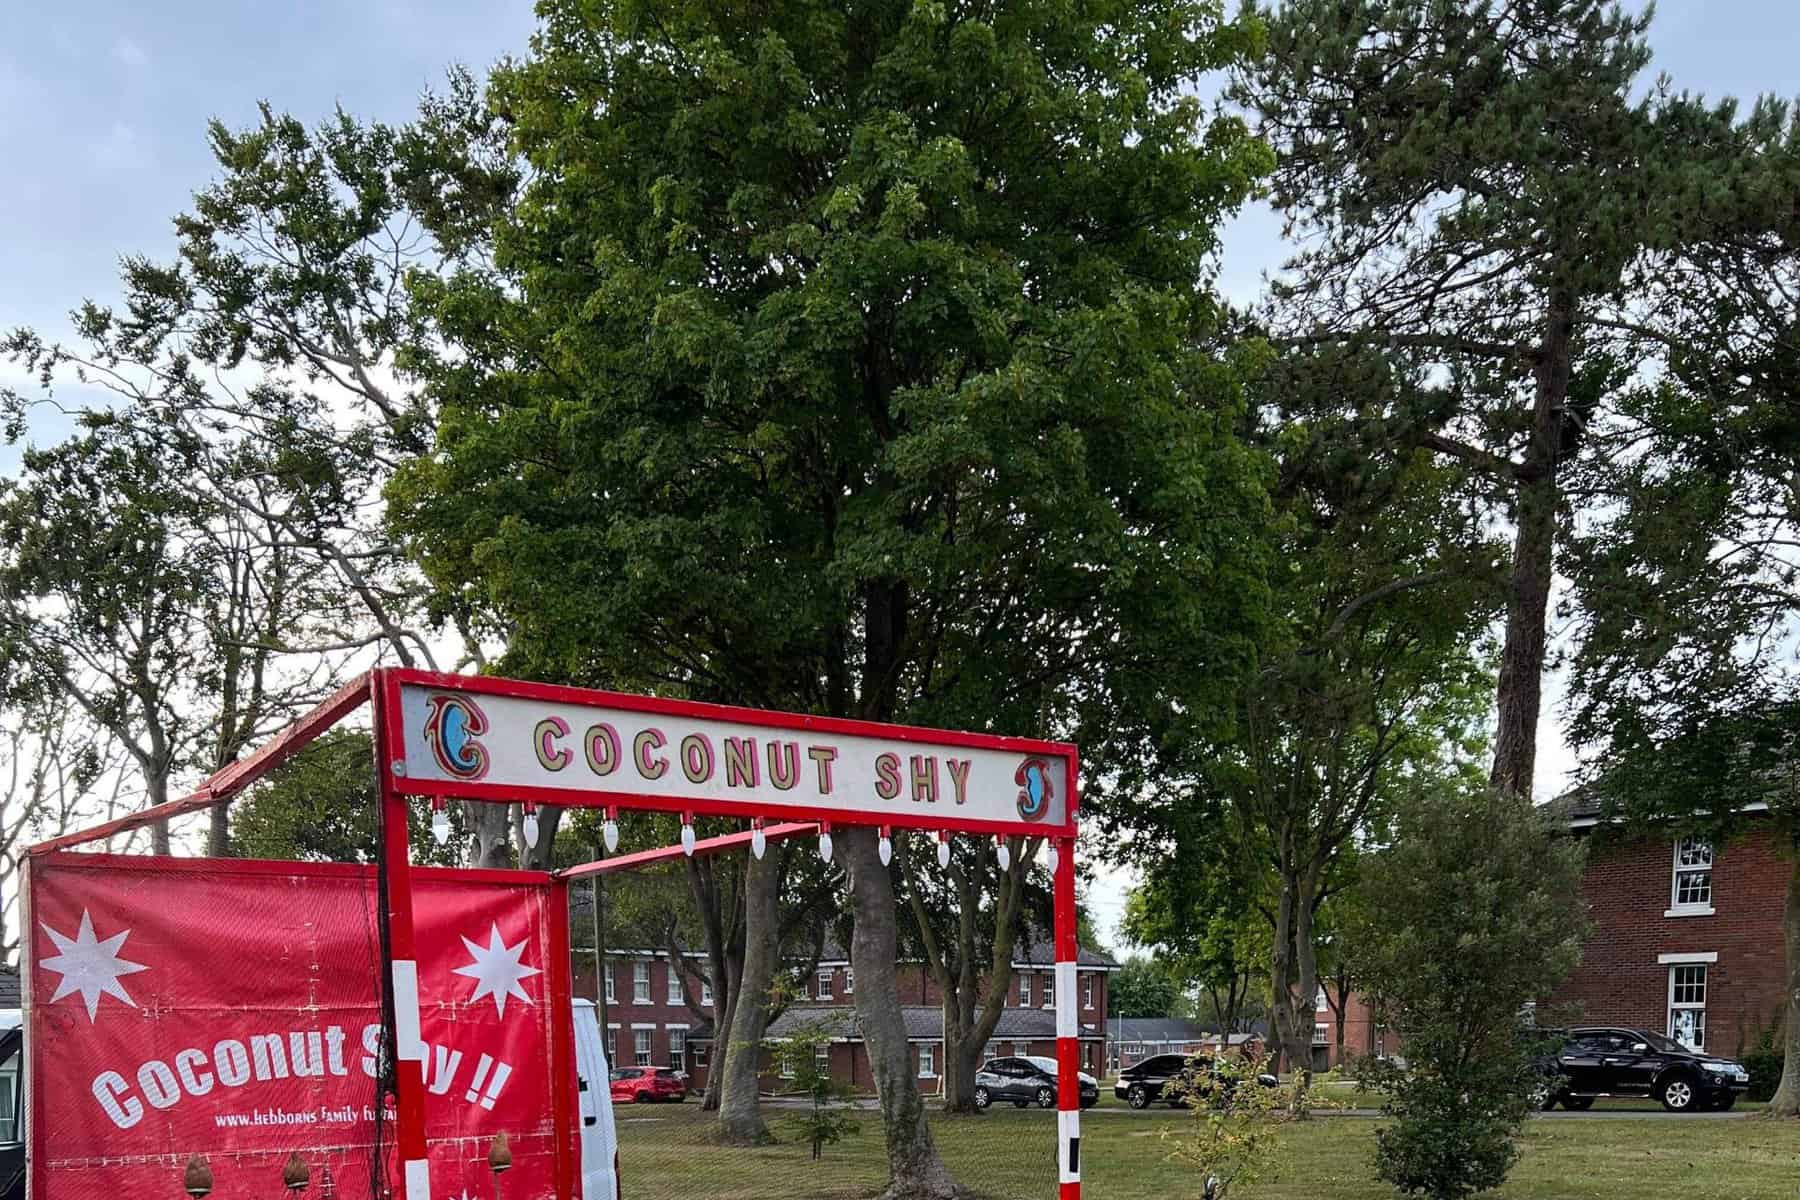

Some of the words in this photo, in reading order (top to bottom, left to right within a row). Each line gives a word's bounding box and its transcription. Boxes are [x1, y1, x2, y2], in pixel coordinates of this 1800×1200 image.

[533, 716, 838, 794] COCONUT
[874, 752, 973, 805] SHY
[91, 1025, 348, 1129] Coconut
